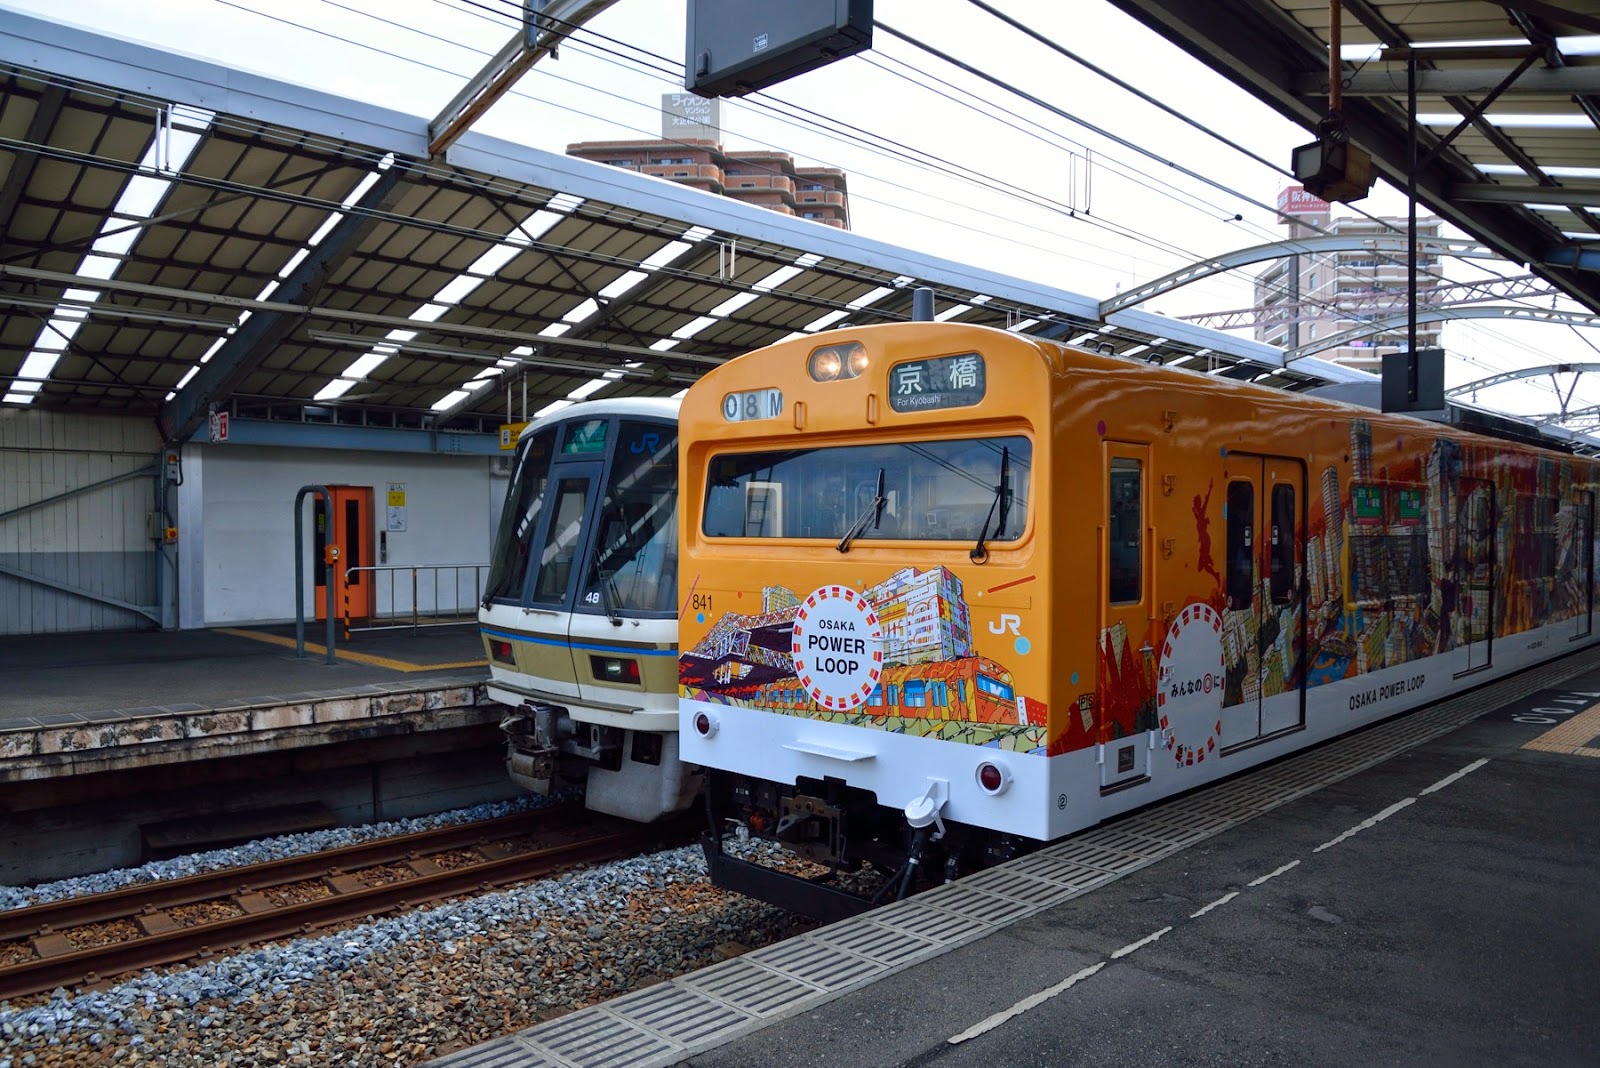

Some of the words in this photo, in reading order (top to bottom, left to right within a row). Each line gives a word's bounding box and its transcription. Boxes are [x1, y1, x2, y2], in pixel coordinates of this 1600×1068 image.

[897, 357, 977, 394] 京橋
[897, 398, 908, 407] For
[630, 432, 660, 454] JR
[585, 591, 600, 604] 48
[692, 594, 712, 611] 841
[819, 619, 855, 631] OSAKA
[988, 614, 1021, 636] JR
[808, 634, 865, 655] POWER
[815, 656, 859, 676] LOOP
[1349, 690, 1377, 711] OSAKA
[1379, 680, 1406, 702] POWER
[1407, 674, 1425, 692] LOOP
